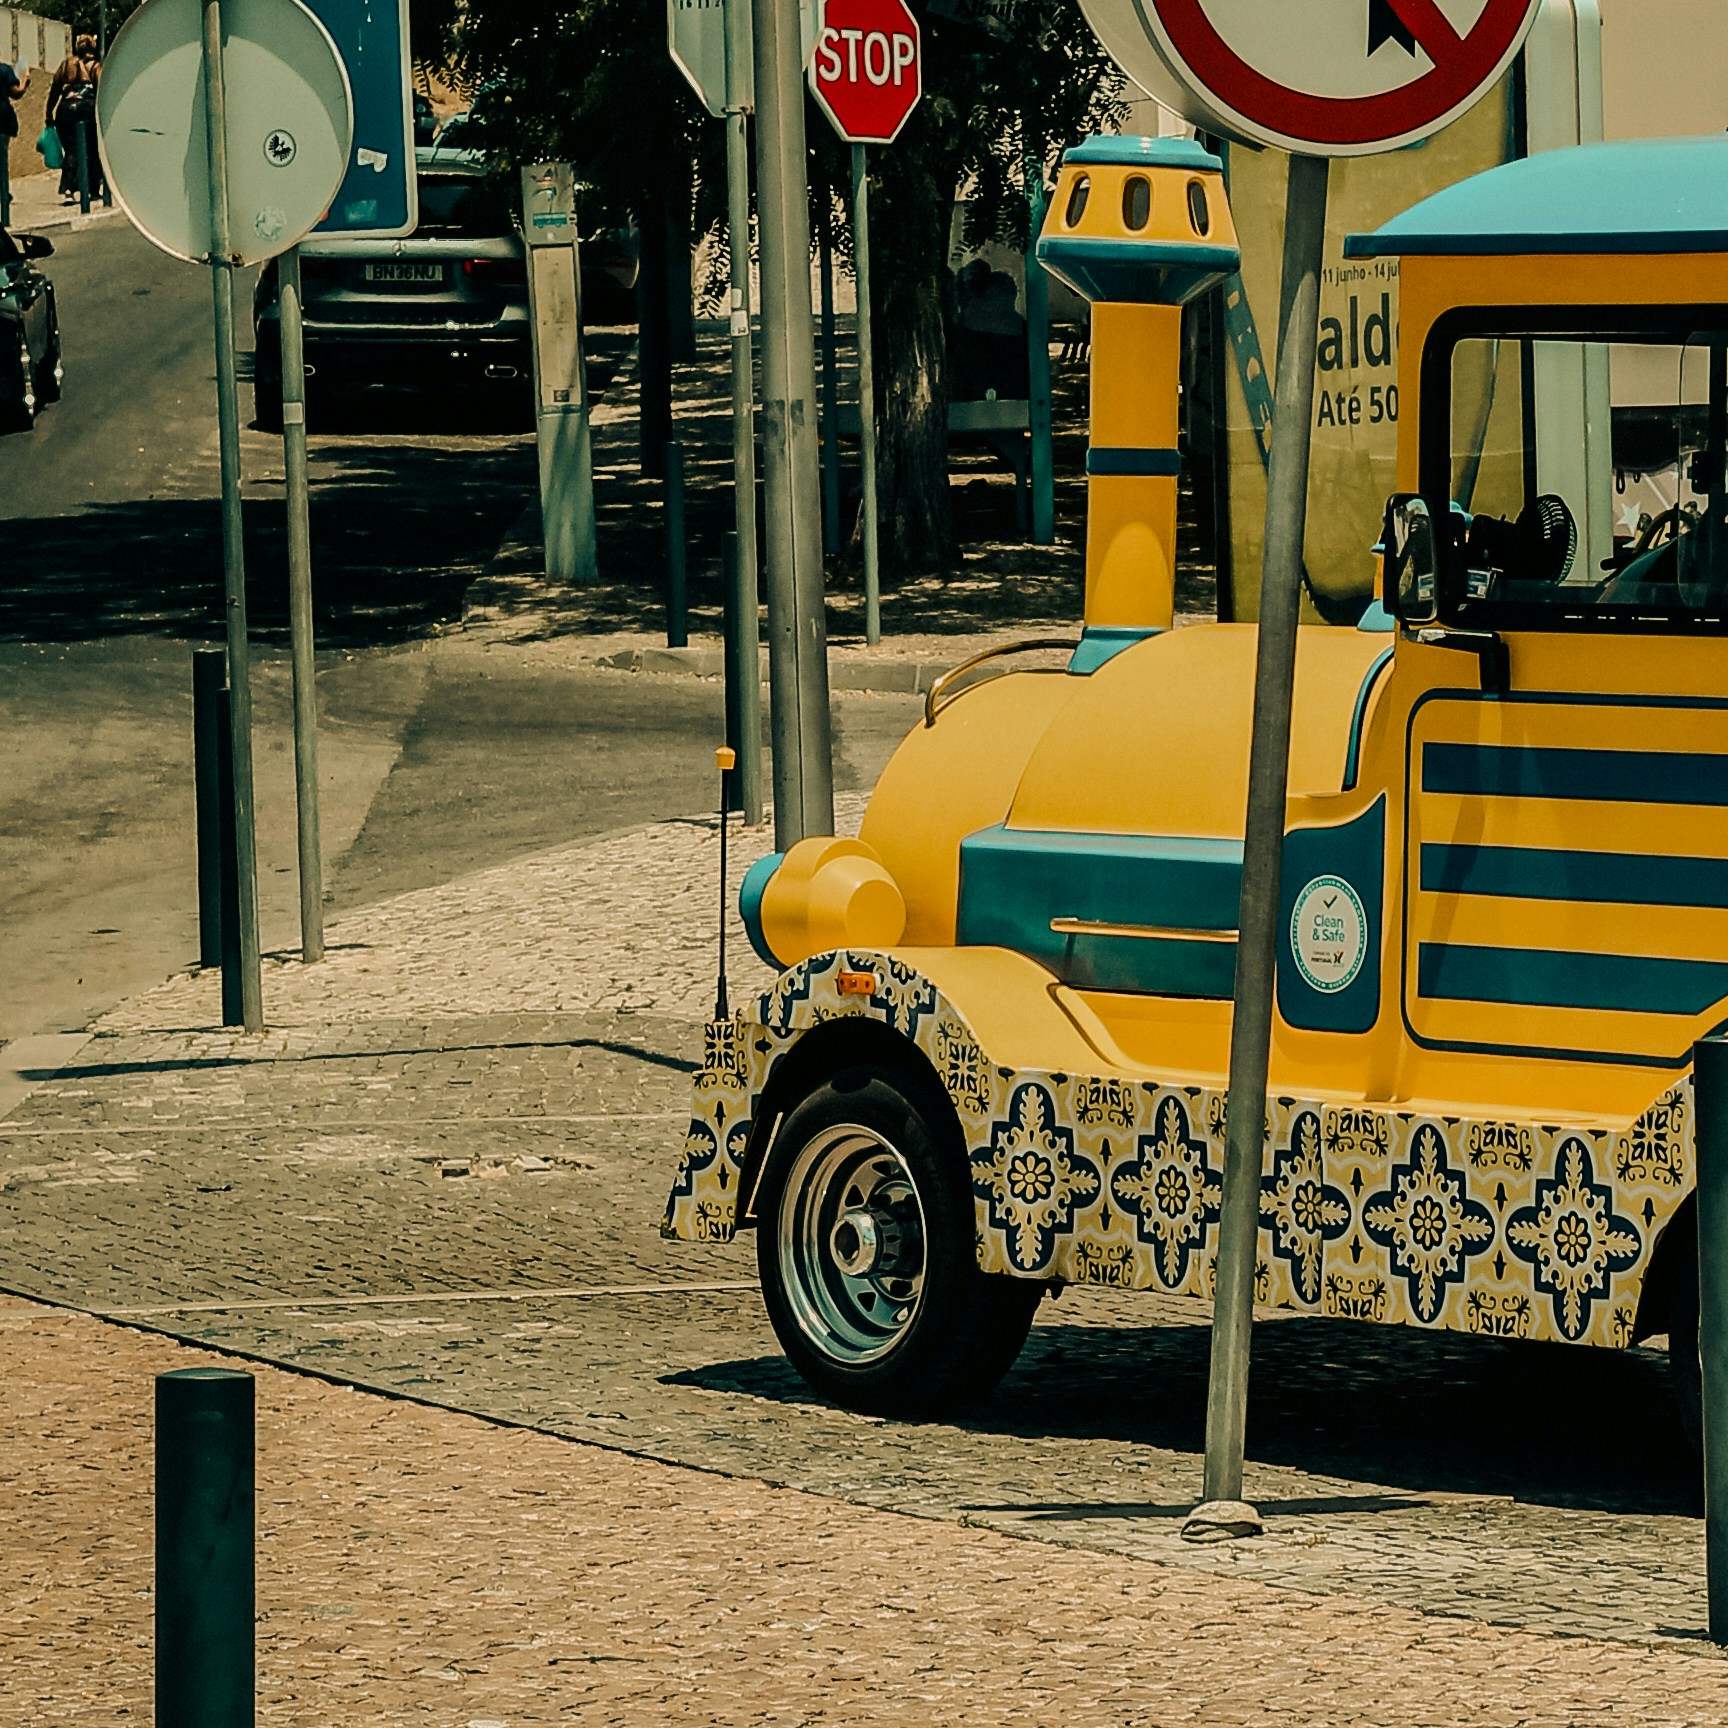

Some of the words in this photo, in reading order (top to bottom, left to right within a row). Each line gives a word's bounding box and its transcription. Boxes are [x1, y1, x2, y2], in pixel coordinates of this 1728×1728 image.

[819, 27, 915, 86] STOP
[1322, 268, 1334, 283] 11
[1335, 266, 1366, 286] junho
[1373, 264, 1386, 279] 14
[1317, 292, 1399, 372] ald
[1317, 385, 1362, 427] Até
[1312, 929, 1320, 941] &
[1322, 928, 1345, 942] Safe
[1313, 914, 1344, 928] Clean
